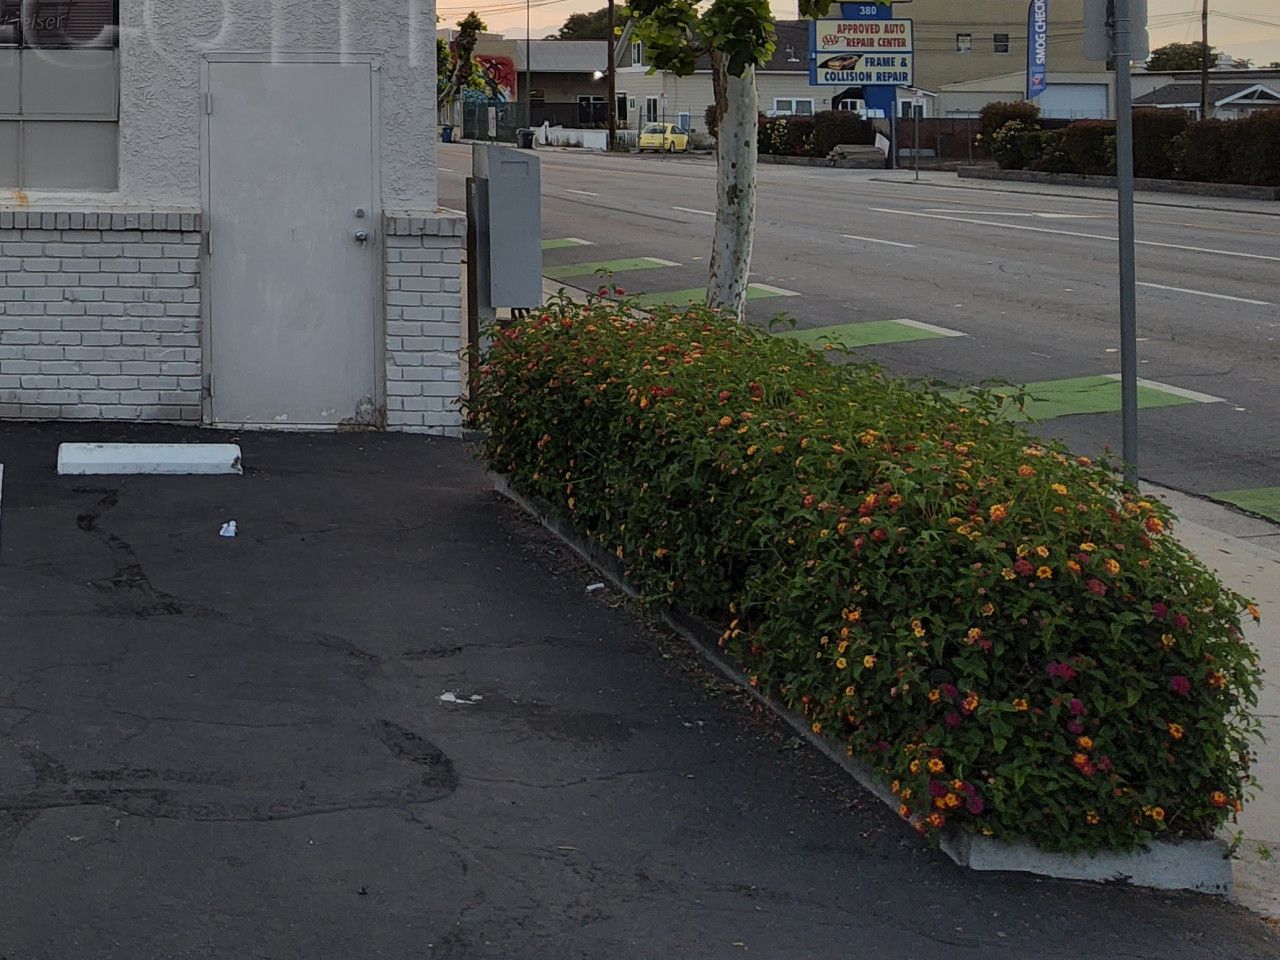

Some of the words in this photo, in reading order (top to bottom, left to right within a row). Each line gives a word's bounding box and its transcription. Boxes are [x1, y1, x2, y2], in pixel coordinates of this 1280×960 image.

[859, 6, 877, 15] 380
[836, 23, 880, 34] APPROVED
[883, 23, 905, 34] AUTO
[846, 37, 875, 48] REPAIR
[877, 37, 907, 48] CENTER
[1034, 33, 1046, 64] SMOG
[864, 56, 896, 67] FRAME
[900, 56, 908, 67] &
[824, 71, 872, 82] COLLISION
[876, 71, 909, 82] REPAIR
